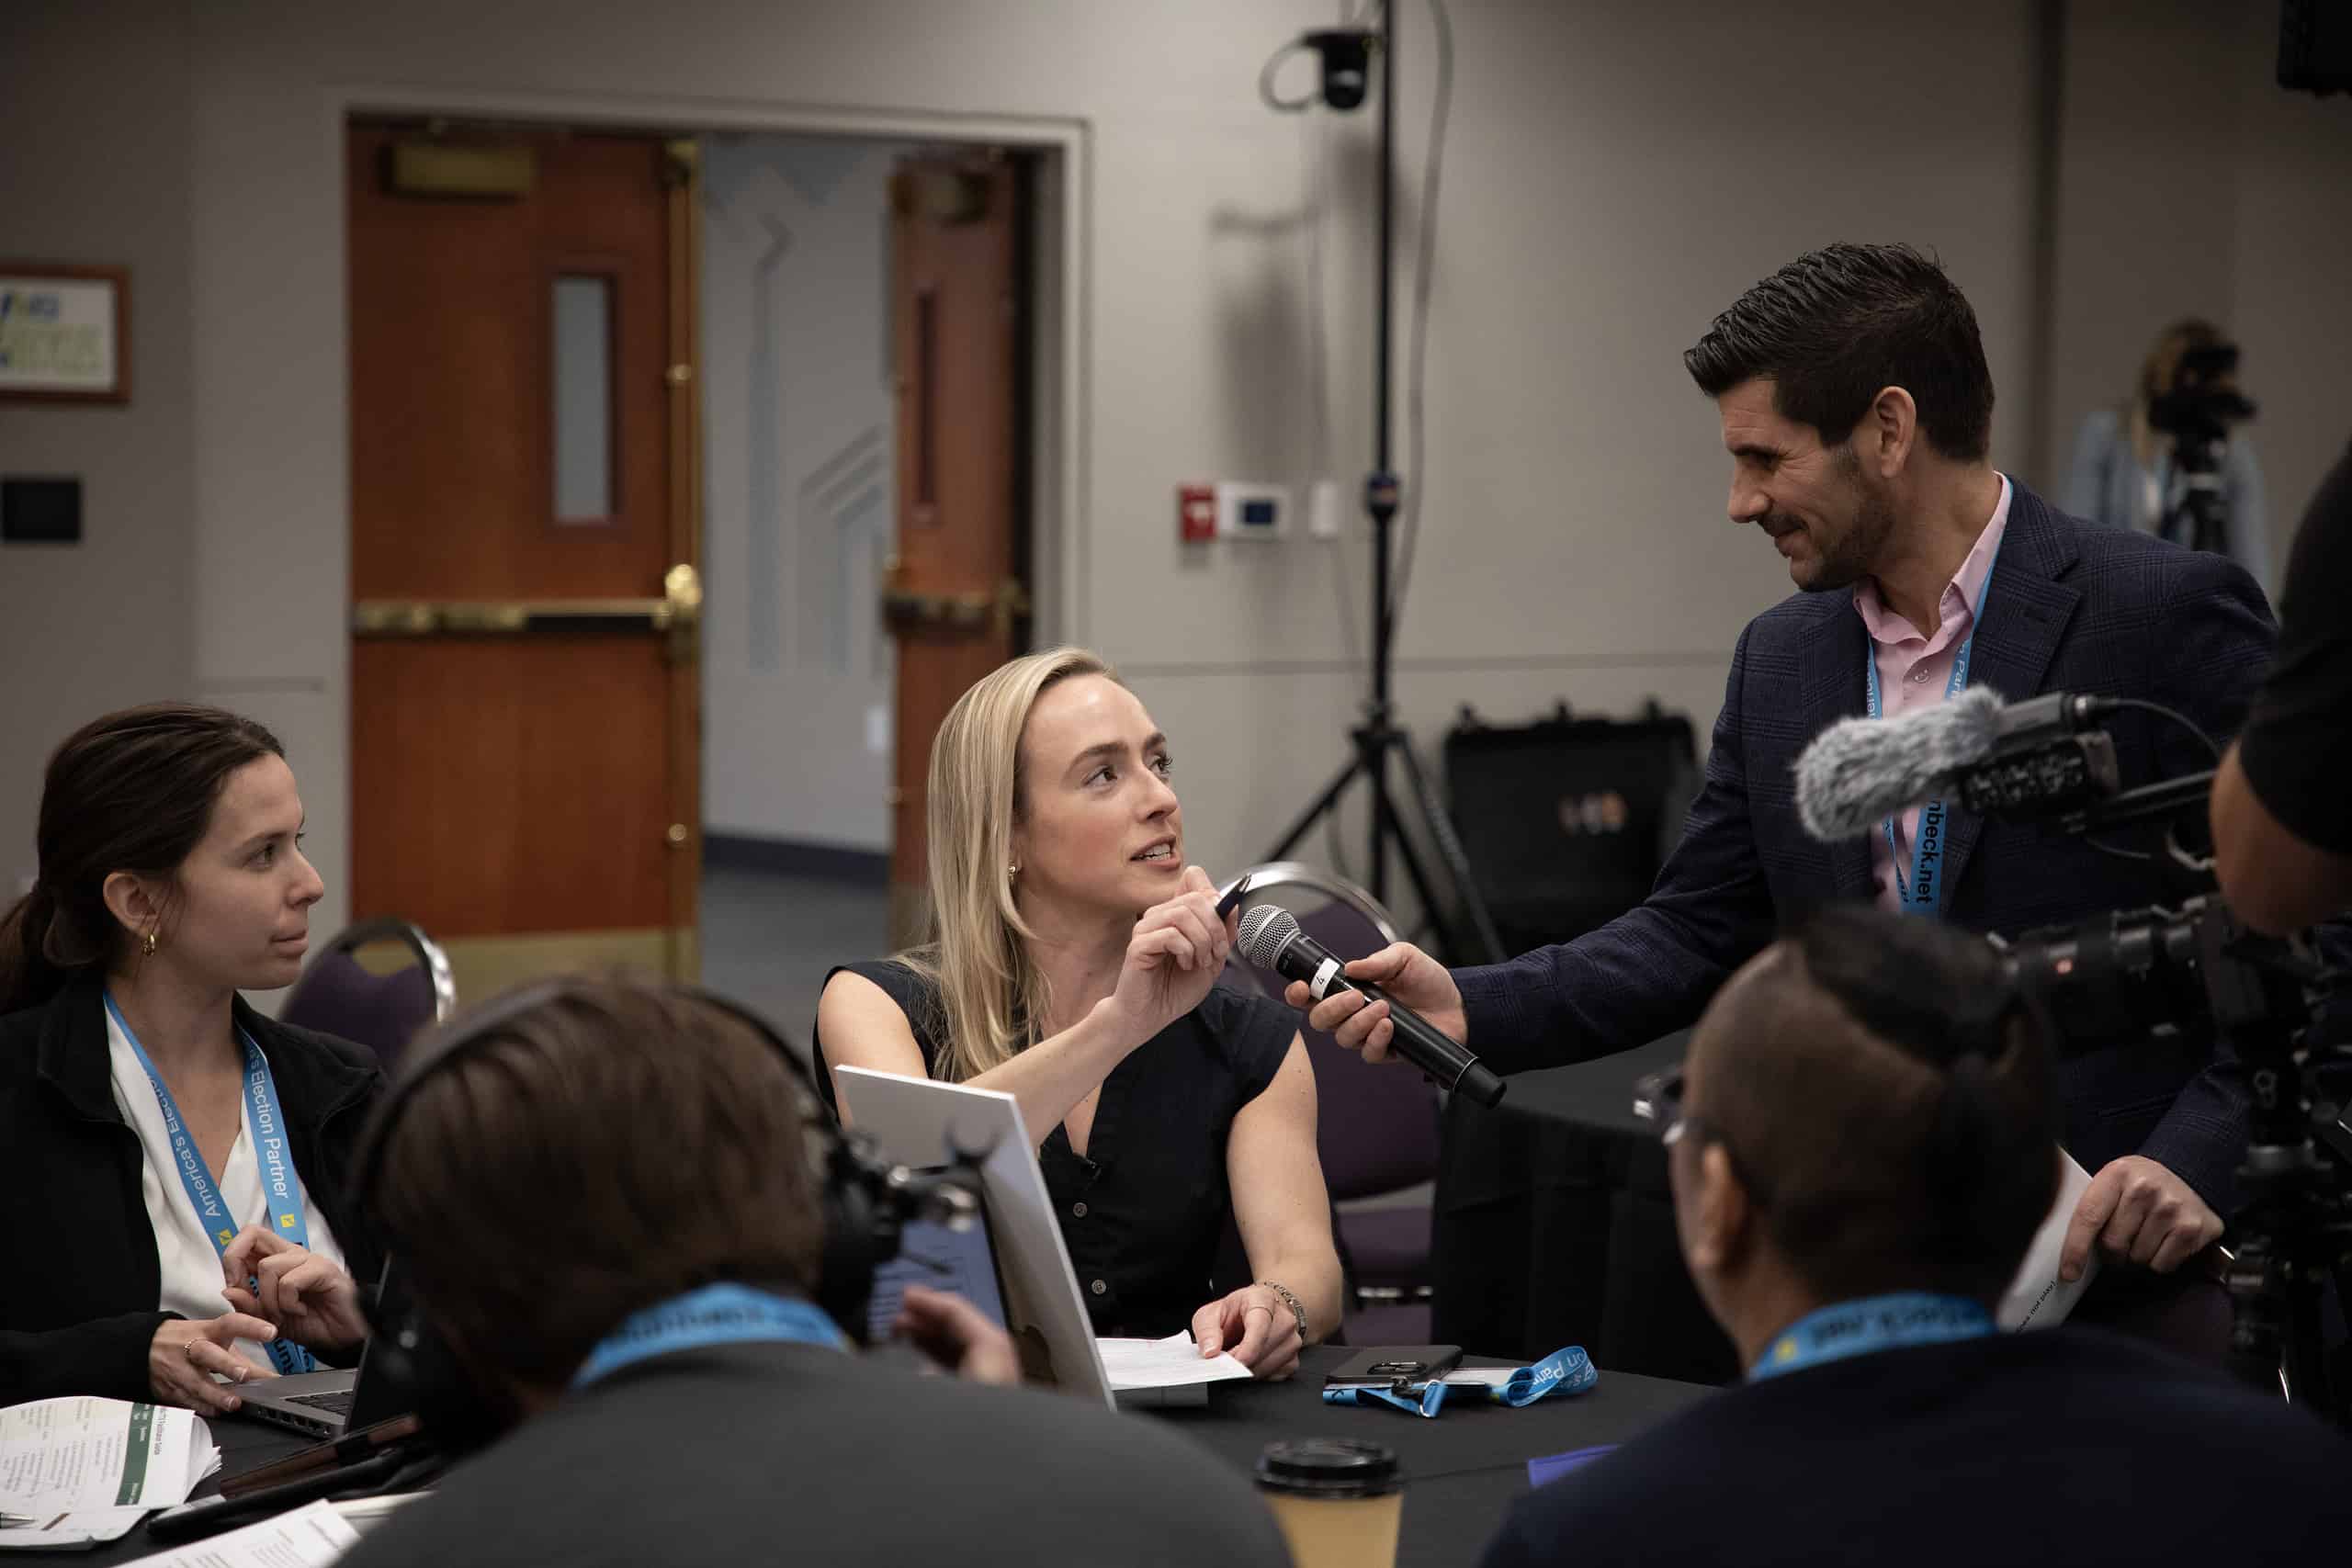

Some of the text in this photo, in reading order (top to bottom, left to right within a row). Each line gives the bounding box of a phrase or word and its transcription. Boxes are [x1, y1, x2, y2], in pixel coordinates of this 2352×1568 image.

[1916, 800, 1945, 904] nbeck.net
[1316, 976, 1325, 985] 4
[175, 1134, 221, 1218] America's
[250, 1067, 274, 1134] Election
[264, 1138, 288, 1199] Partner
